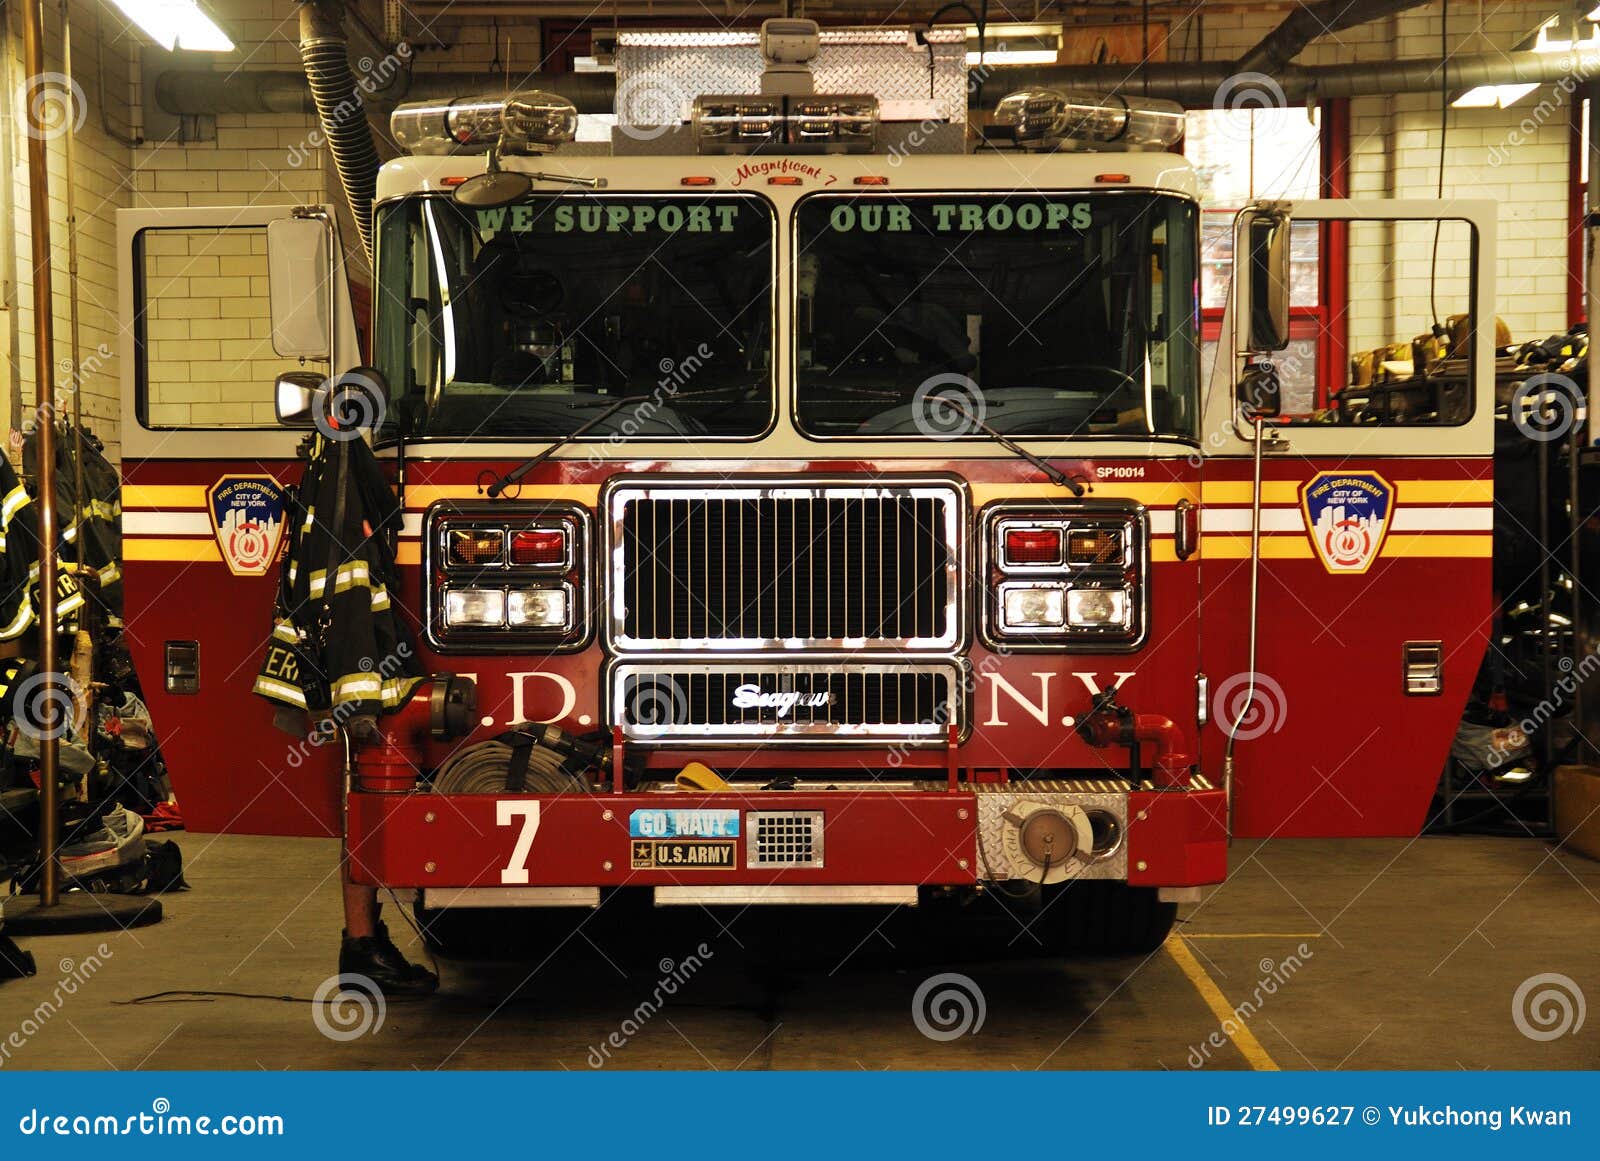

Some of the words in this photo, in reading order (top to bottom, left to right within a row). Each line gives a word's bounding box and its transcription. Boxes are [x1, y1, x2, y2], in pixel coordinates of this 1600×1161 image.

[731, 158, 822, 187] Magnificent
[823, 174, 838, 186] 7
[476, 206, 533, 232] WE
[554, 205, 739, 232] SUPPORT
[830, 204, 912, 232] OUR
[933, 203, 1093, 231] TROOPS
[1096, 467, 1145, 478] SP10014
[217, 486, 233, 501] FIRE
[233, 482, 279, 501] DEPARTMENT
[1312, 484, 1330, 498] FIRE
[1330, 479, 1383, 497] DEPARTMENT
[640, 812, 668, 836] GO
[496, 800, 541, 884] 7
[658, 846, 731, 863] U.S.ARMY
